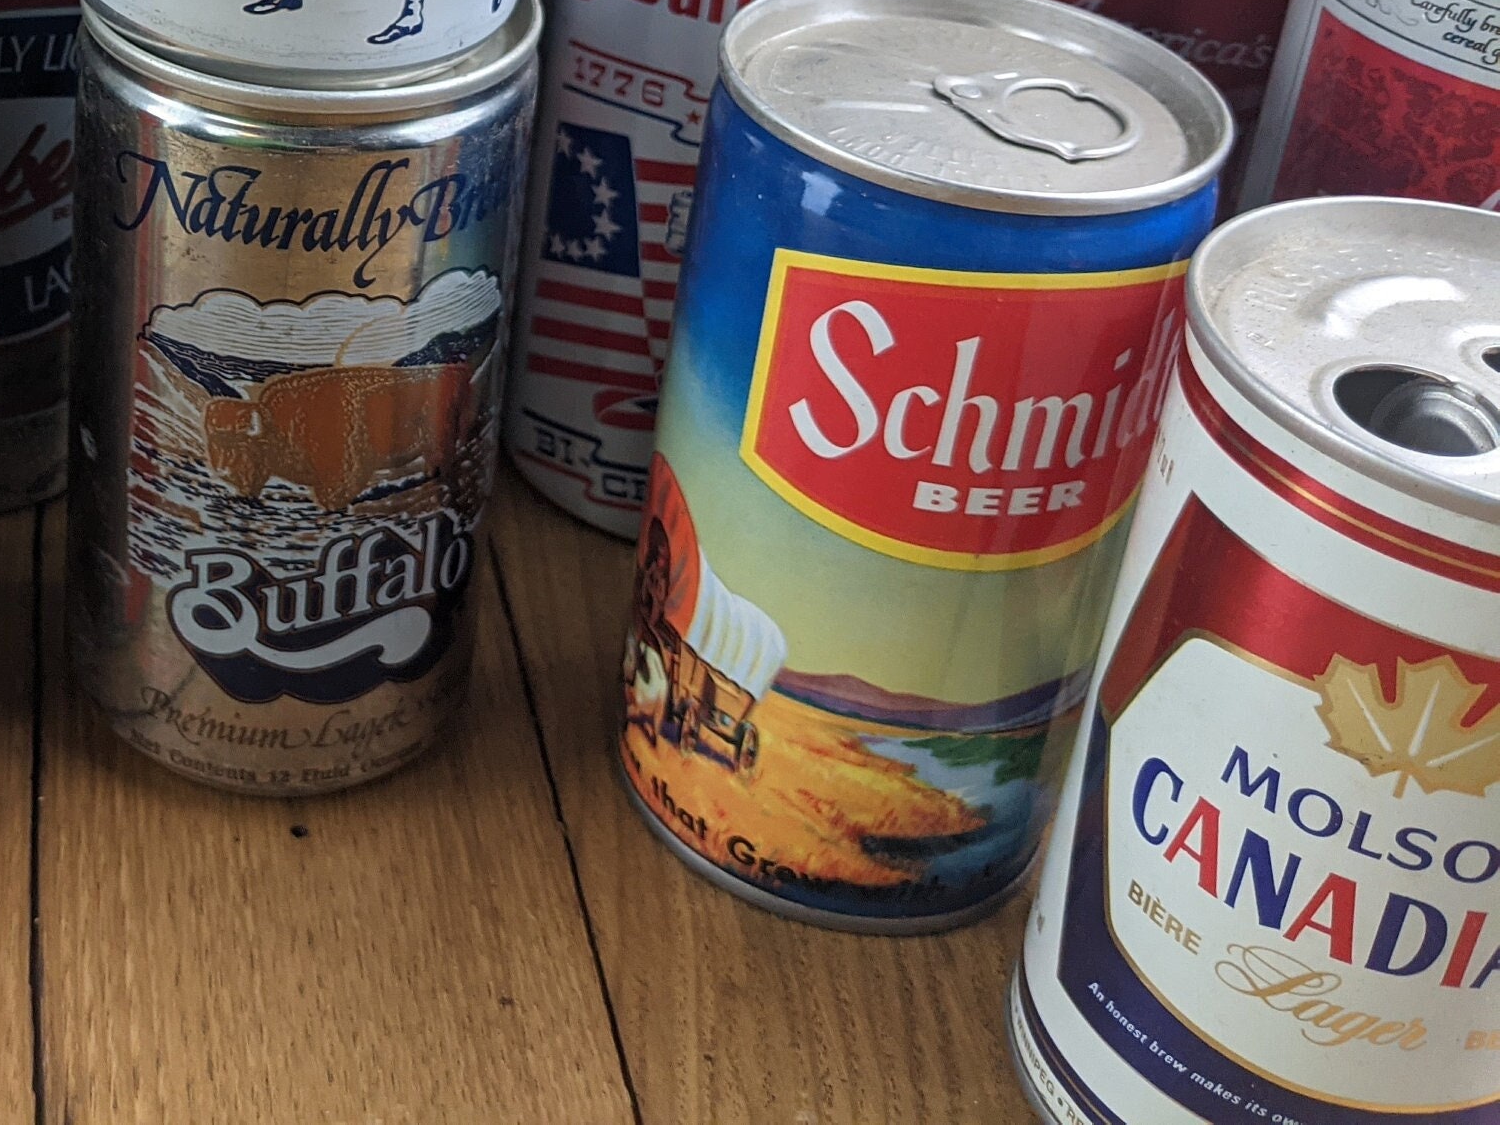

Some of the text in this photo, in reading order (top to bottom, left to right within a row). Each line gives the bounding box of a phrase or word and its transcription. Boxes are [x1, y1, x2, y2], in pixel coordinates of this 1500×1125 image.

[1442, 30, 1489, 54] cereal
[570, 55, 667, 108] 1776
[113, 150, 411, 288] Naturally
[913, 481, 1087, 518] BEER
[170, 507, 472, 672] Buffalo
[141, 684, 310, 750] Premium
[1127, 878, 1203, 956] BIÈRE
[1214, 943, 1428, 1051] Lager
[1087, 980, 1269, 1118] An honest brew makes its
